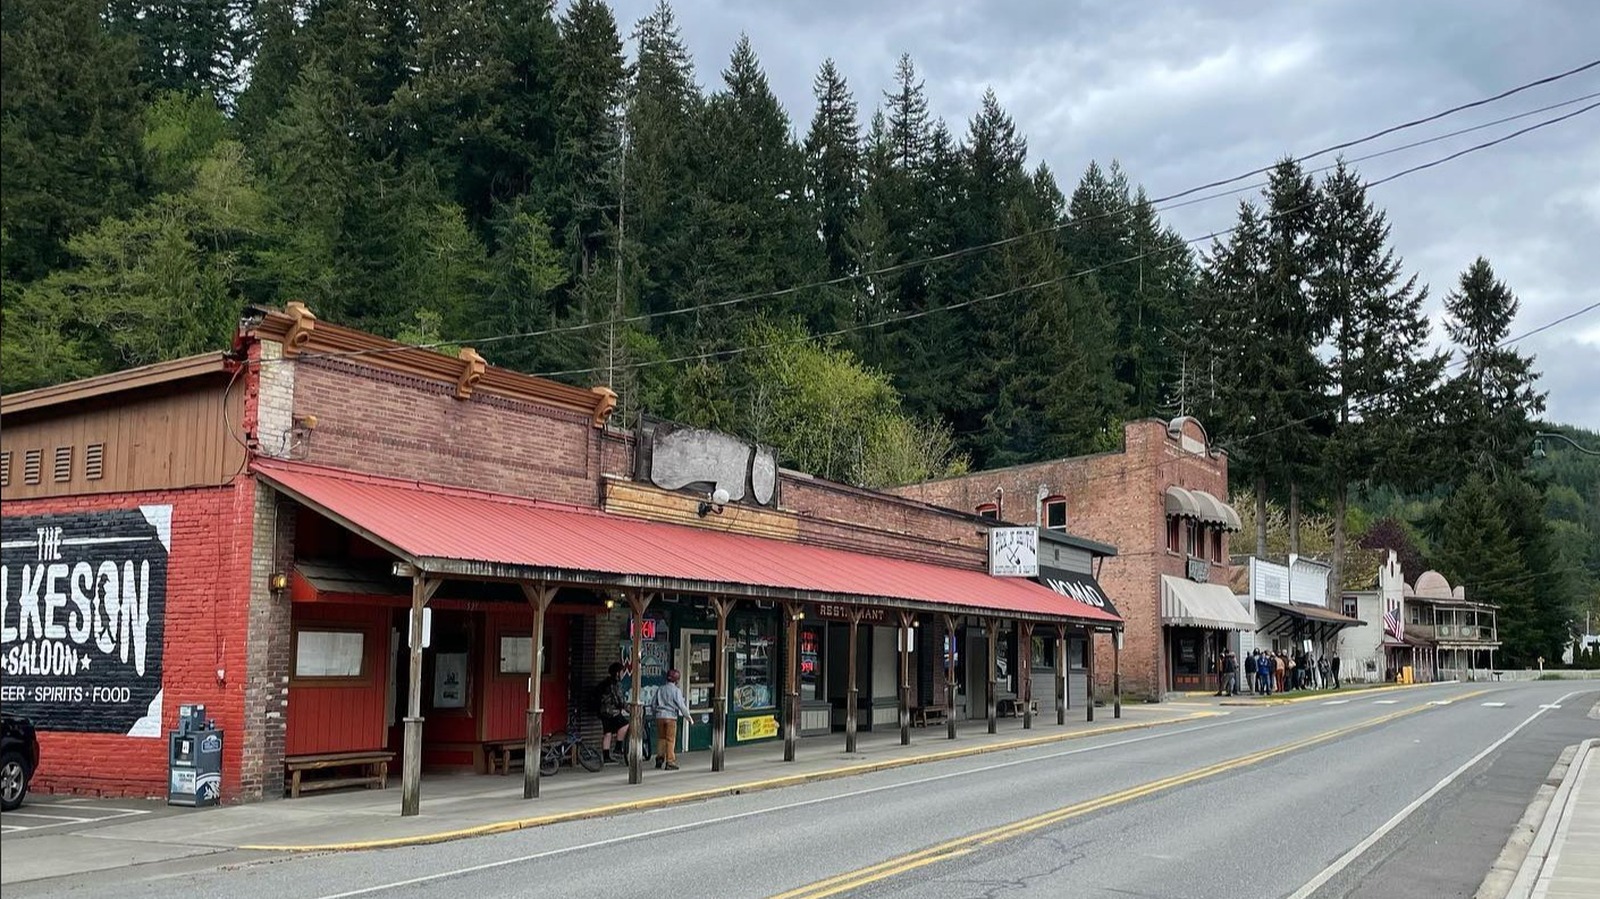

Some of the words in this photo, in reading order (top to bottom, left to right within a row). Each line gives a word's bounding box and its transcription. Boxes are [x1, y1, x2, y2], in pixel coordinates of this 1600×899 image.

[37, 526, 63, 561] THE
[0, 559, 150, 677] LKESON
[820, 604, 884, 620] RESTANT
[7, 639, 78, 676] SALOON
[34, 686, 83, 702] SPIRITS
[92, 687, 131, 702] FOOD
